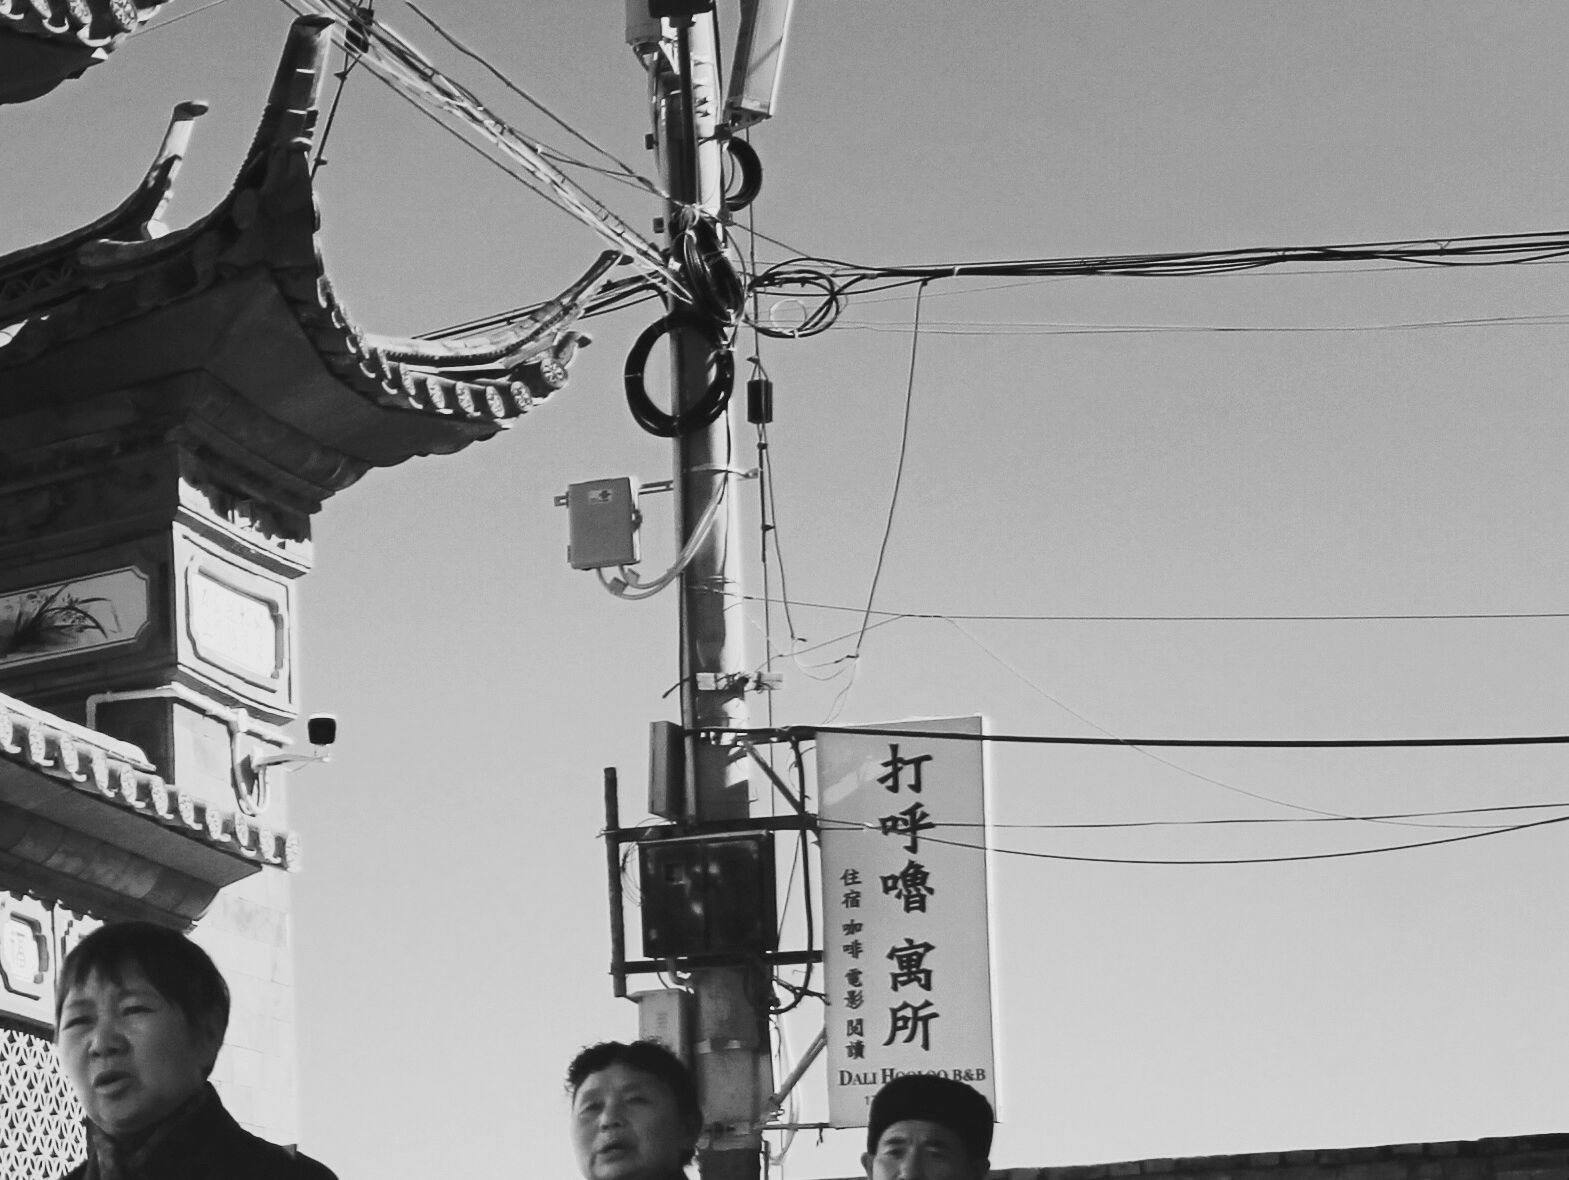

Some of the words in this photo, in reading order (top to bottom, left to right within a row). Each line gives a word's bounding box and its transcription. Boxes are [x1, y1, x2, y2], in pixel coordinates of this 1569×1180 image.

[839, 868, 862, 909] 住宿
[842, 919, 864, 959] 咖啡
[843, 968, 864, 1009] 電影
[883, 937, 940, 1052] 寓所
[839, 1070, 877, 1086] DALI
[952, 1068, 986, 1082] B&B
